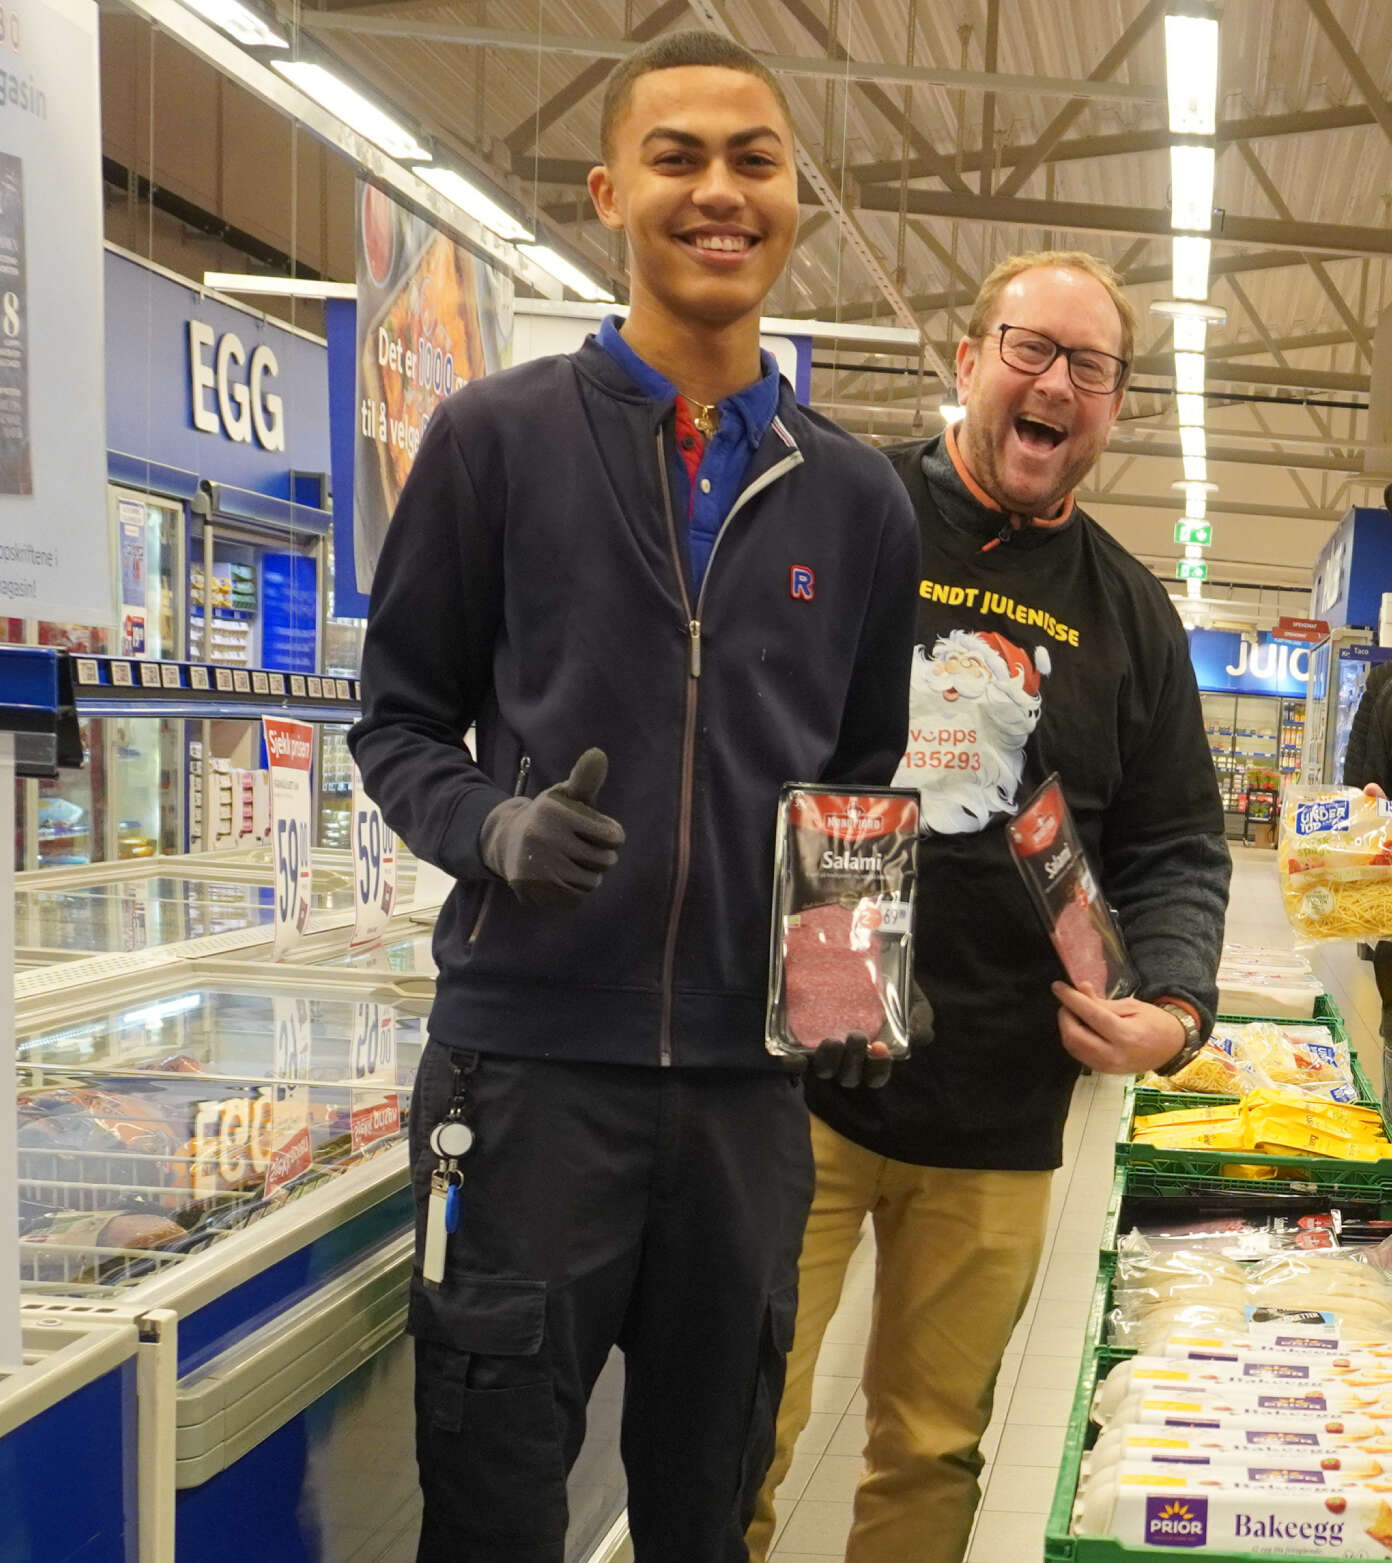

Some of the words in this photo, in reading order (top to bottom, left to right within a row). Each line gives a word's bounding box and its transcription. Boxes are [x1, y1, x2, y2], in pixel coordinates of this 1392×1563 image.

[378, 326, 403, 374] Det
[405, 353, 417, 379] er
[418, 337, 454, 397] 1000
[188, 319, 285, 452] EGG
[361, 400, 376, 439] til
[378, 403, 387, 443] å
[390, 413, 420, 459] velge
[789, 564, 815, 601] R
[919, 579, 979, 608] ENDT
[980, 591, 1080, 648] JULENISSE
[1354, 647, 1369, 655] Taco
[269, 730, 290, 758] Sjekk
[290, 735, 310, 762] prisen
[903, 751, 981, 771] 135293
[1301, 804, 1346, 824] UNDER
[278, 818, 298, 922] 59
[358, 810, 380, 905] 59
[822, 851, 882, 871] Salami
[1150, 1519, 1203, 1535] PRIOR
[1234, 1513, 1345, 1547] Bakeegg
